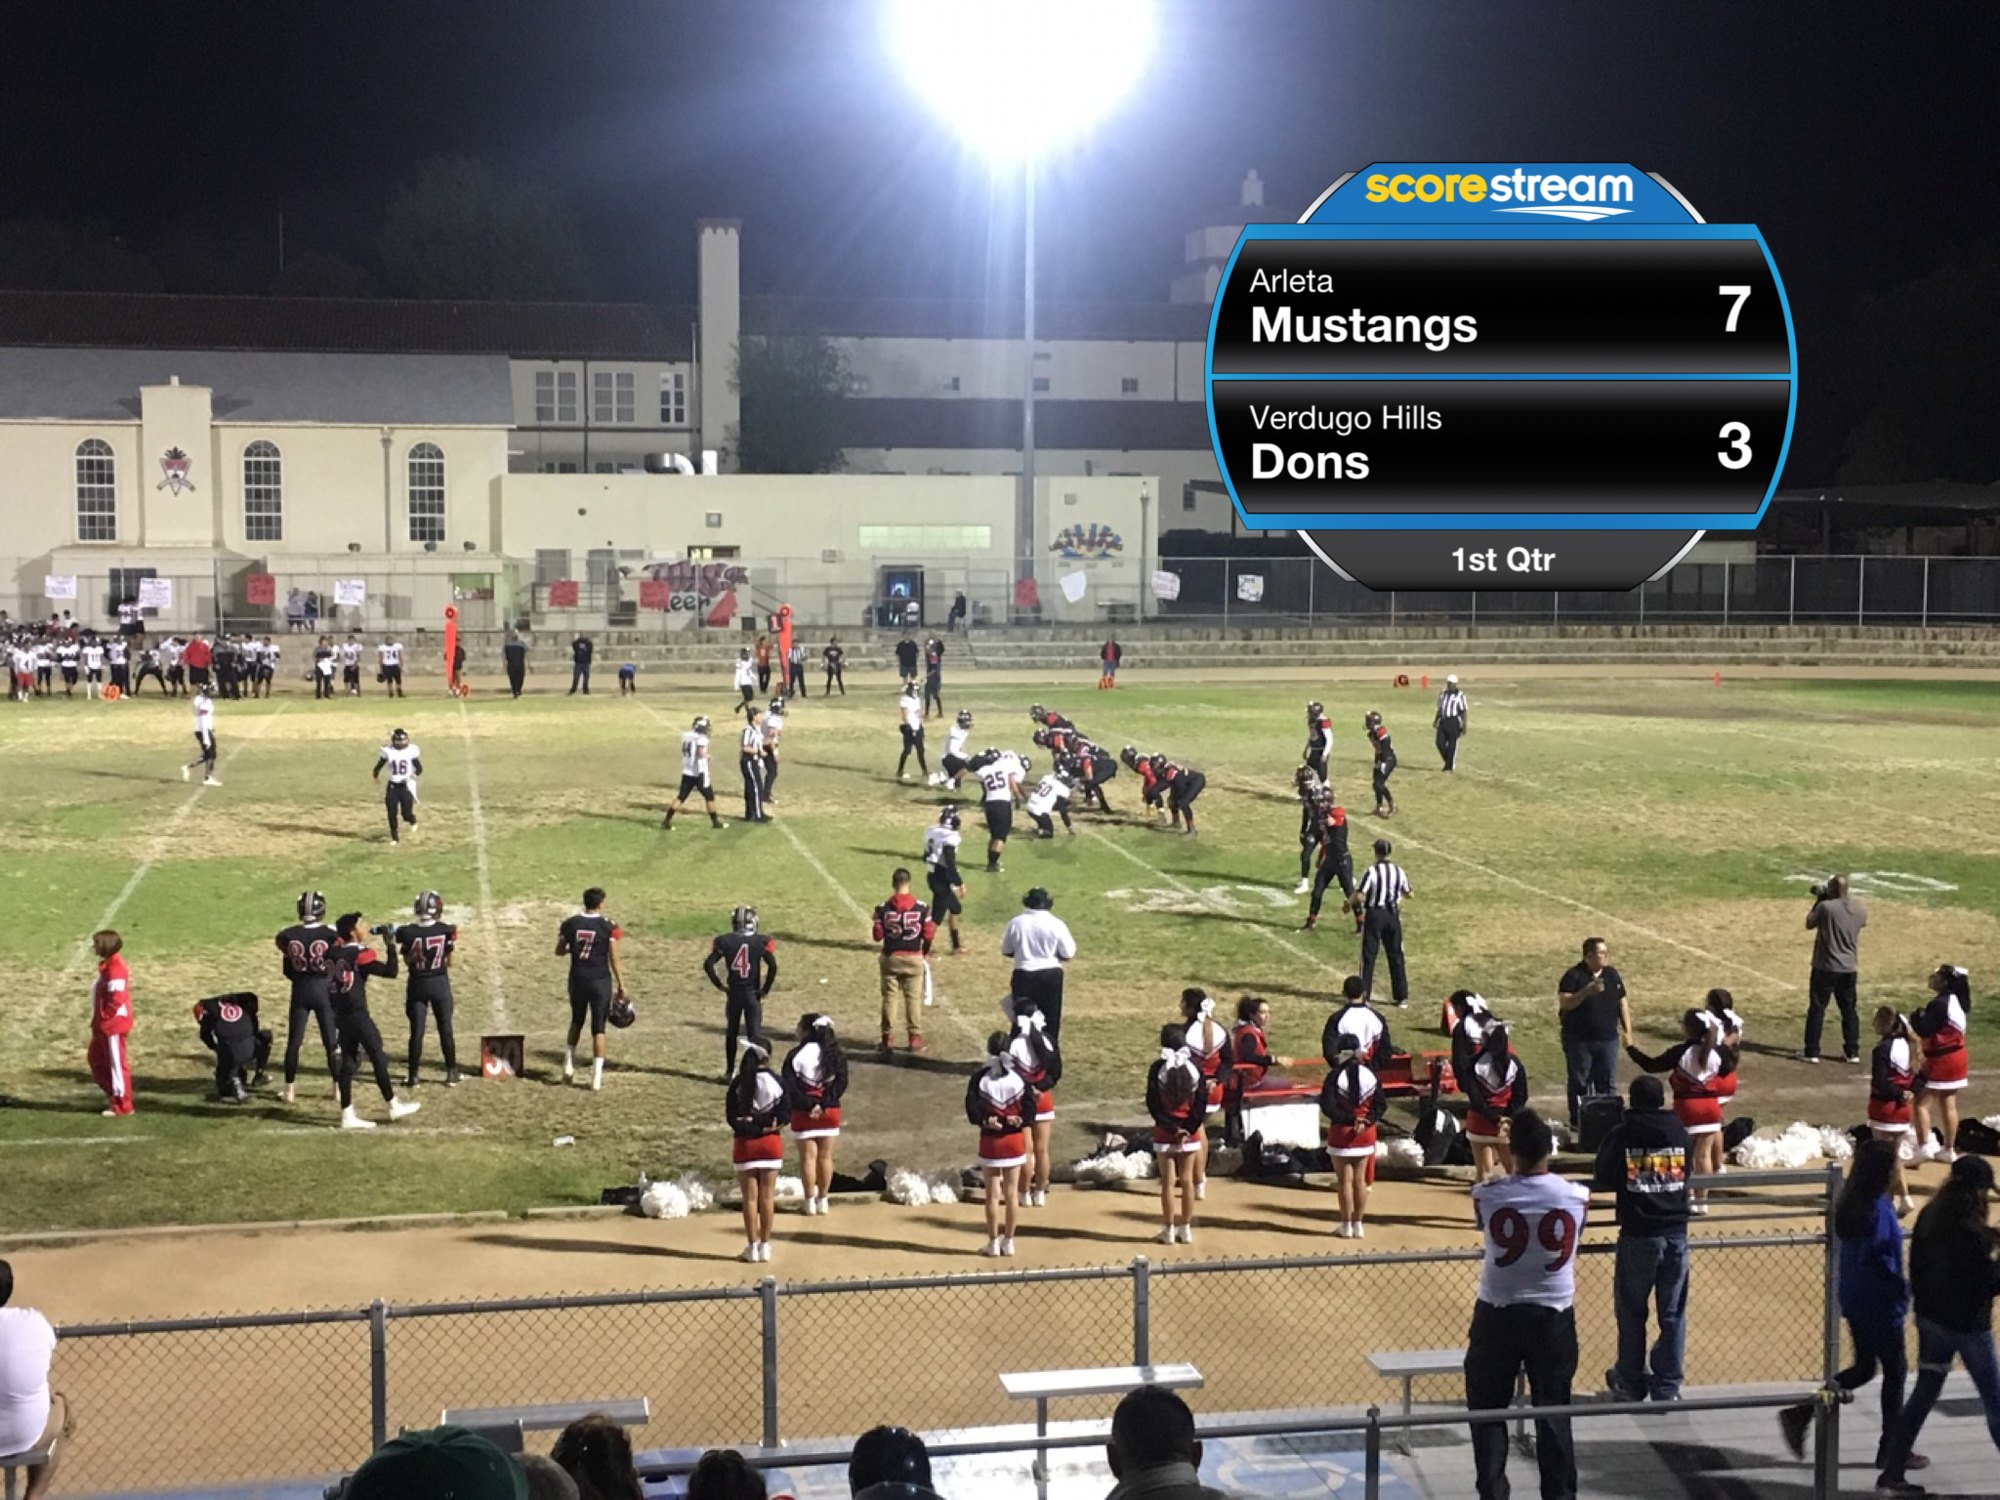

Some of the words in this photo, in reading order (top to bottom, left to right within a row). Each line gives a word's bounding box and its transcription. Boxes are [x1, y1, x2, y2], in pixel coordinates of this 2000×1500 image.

[391, 759, 408, 776] 16
[985, 770, 1006, 792] 25
[884, 910, 922, 941] 55
[288, 939, 330, 972] 88
[411, 934, 447, 971] 47
[576, 929, 597, 960] 7
[731, 943, 751, 979] 4
[1489, 1207, 1576, 1273] 99
